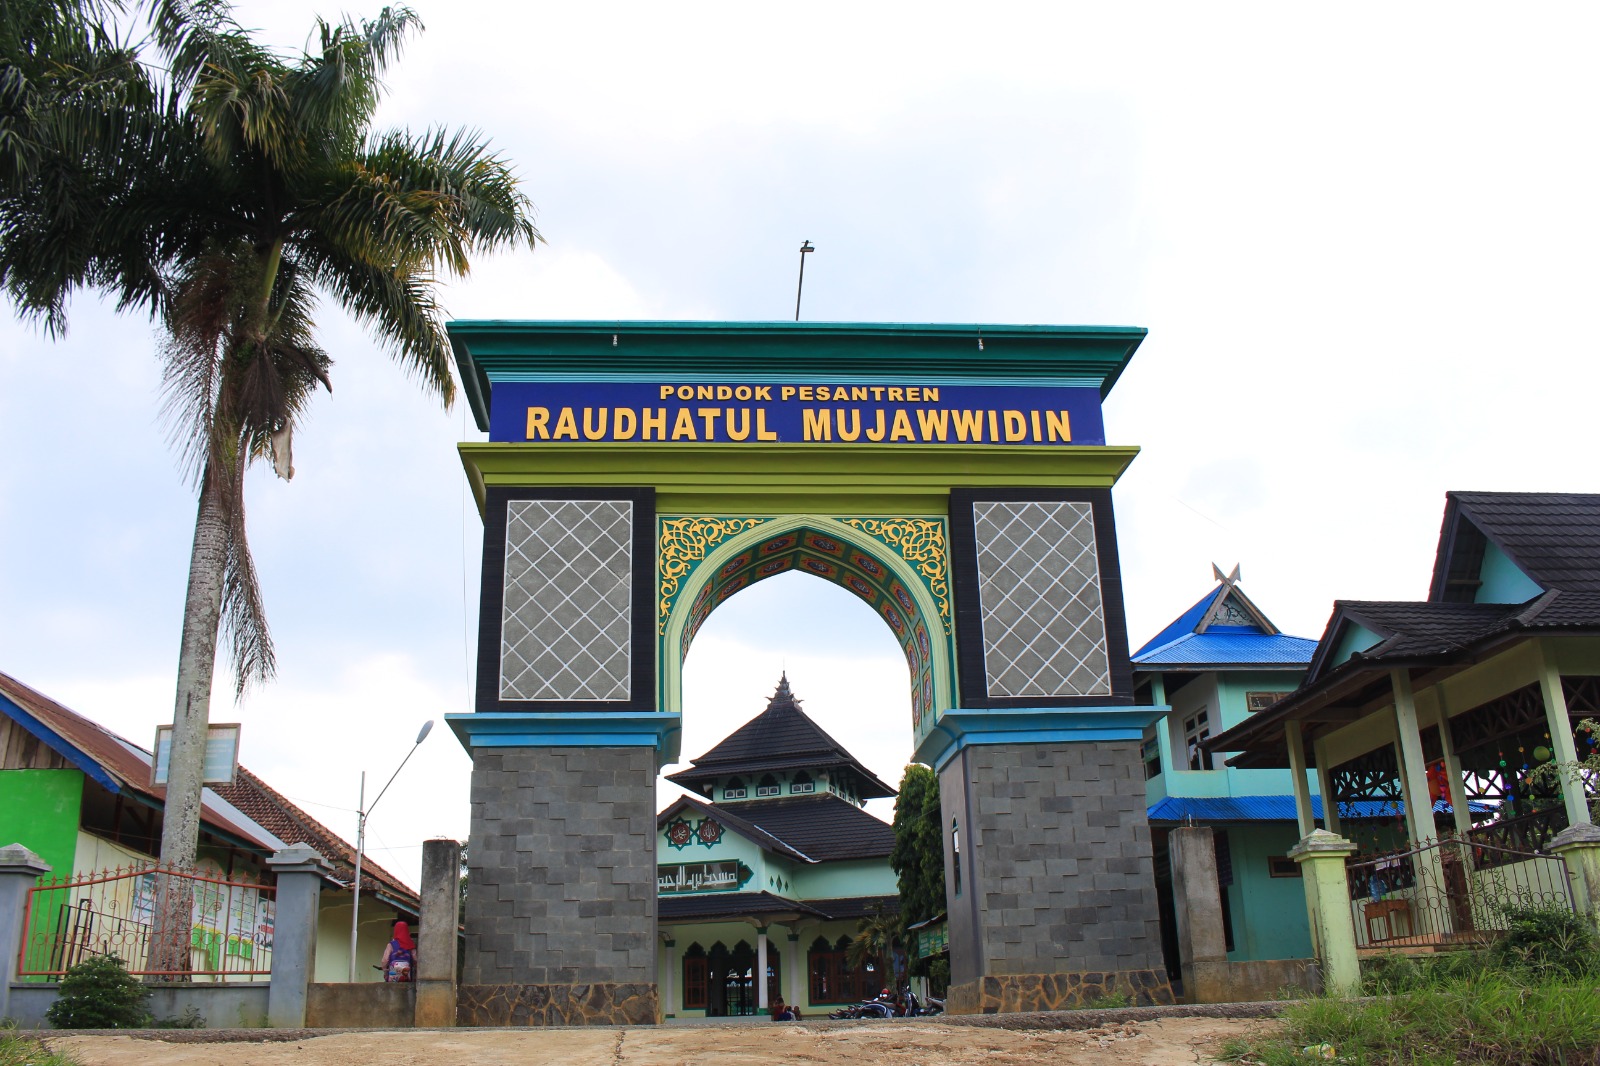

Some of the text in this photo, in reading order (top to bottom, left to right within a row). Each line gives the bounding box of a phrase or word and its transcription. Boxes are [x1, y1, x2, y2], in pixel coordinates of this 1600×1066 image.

[659, 384, 940, 403] PONDOK PESANTREN
[525, 405, 1073, 443] RAUDHATUL MUJAWWIDIN
